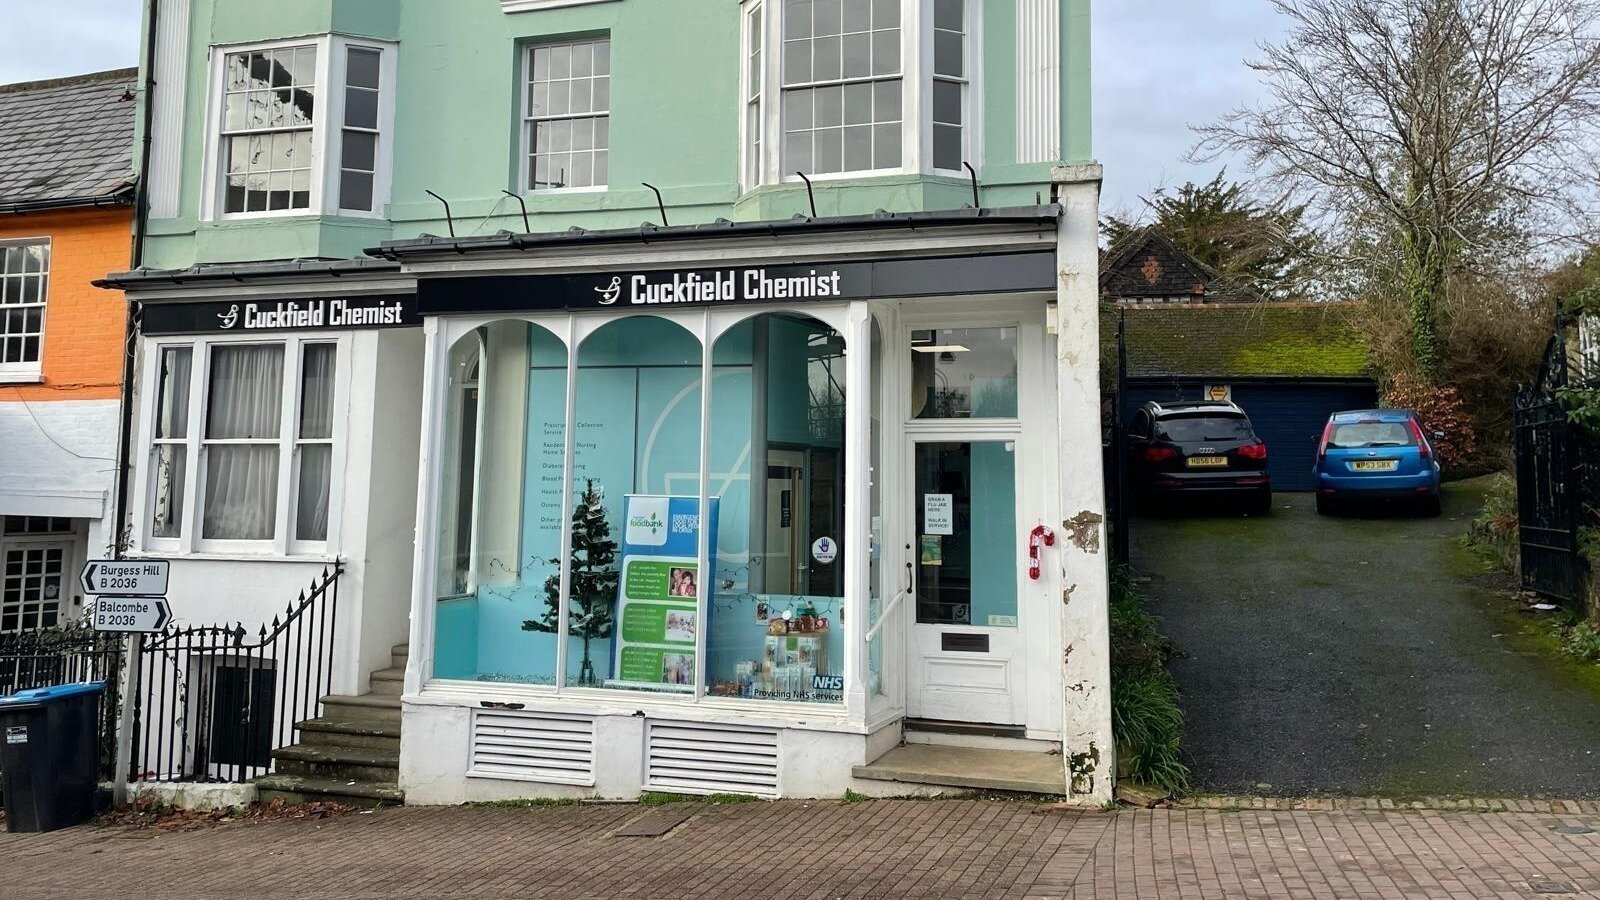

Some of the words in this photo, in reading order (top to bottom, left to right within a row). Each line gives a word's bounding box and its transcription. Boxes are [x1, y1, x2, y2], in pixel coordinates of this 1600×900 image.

[631, 270, 735, 304] Cuckfield
[744, 269, 841, 300] Chemist
[244, 300, 325, 329] Cuckfield
[329, 300, 403, 326] Chemist
[630, 517, 664, 528] foodbank
[101, 565, 140, 577] Burgess
[143, 565, 160, 576] Hill
[101, 578, 108, 588] B
[110, 578, 138, 589] 2036
[100, 601, 149, 613] Balcombe
[98, 614, 106, 625] B
[108, 615, 136, 626] 2036
[813, 676, 843, 690] NHS
[754, 688, 791, 700] Providing
[793, 690, 810, 699] NHS
[811, 692, 844, 701] services
